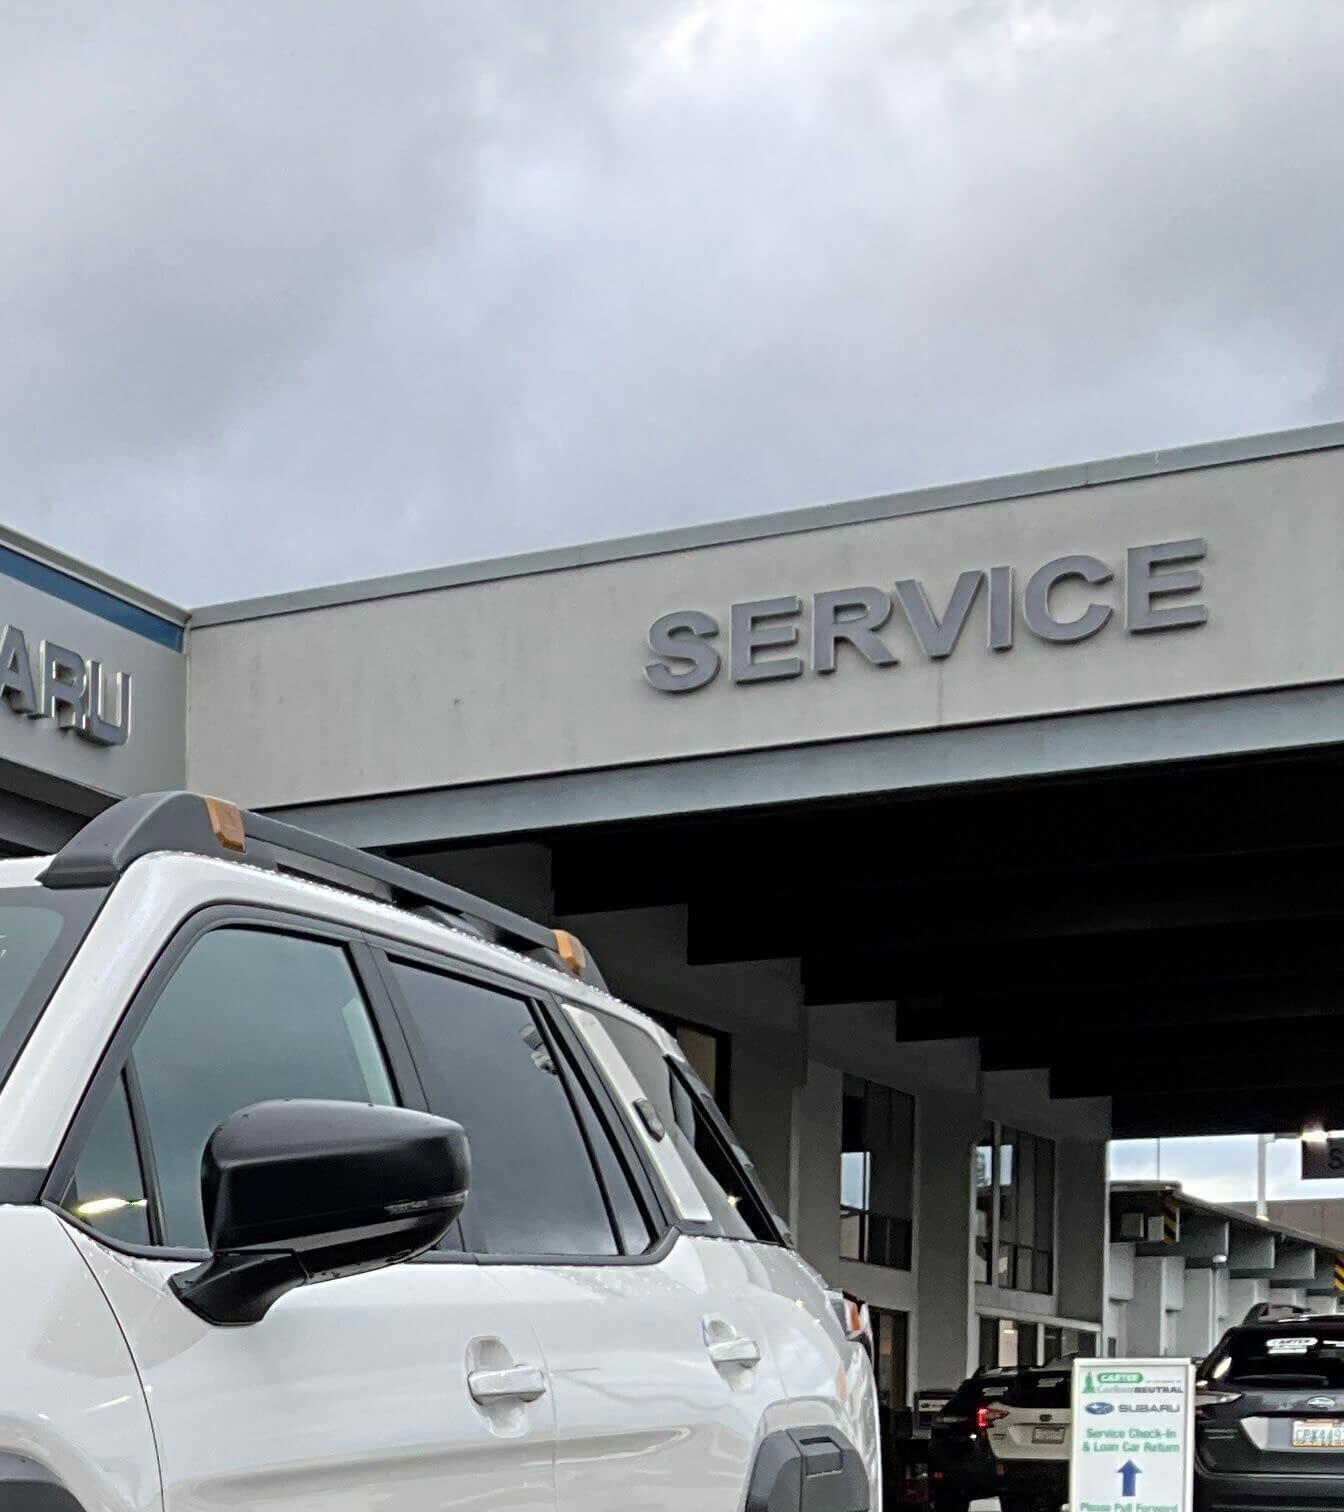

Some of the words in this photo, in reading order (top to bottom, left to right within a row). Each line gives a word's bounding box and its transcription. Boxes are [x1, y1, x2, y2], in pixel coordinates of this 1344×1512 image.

[644, 537, 1208, 693] SERVICE
[1118, 1404, 1181, 1412] SUBARU
[1087, 1428, 1126, 1438] Service
[1093, 1441, 1120, 1451] Loan
[1123, 1441, 1140, 1451] Car
[1144, 1441, 1180, 1451] Return
[1080, 1503, 1112, 1512] Please
[1114, 1503, 1133, 1512] Pull
